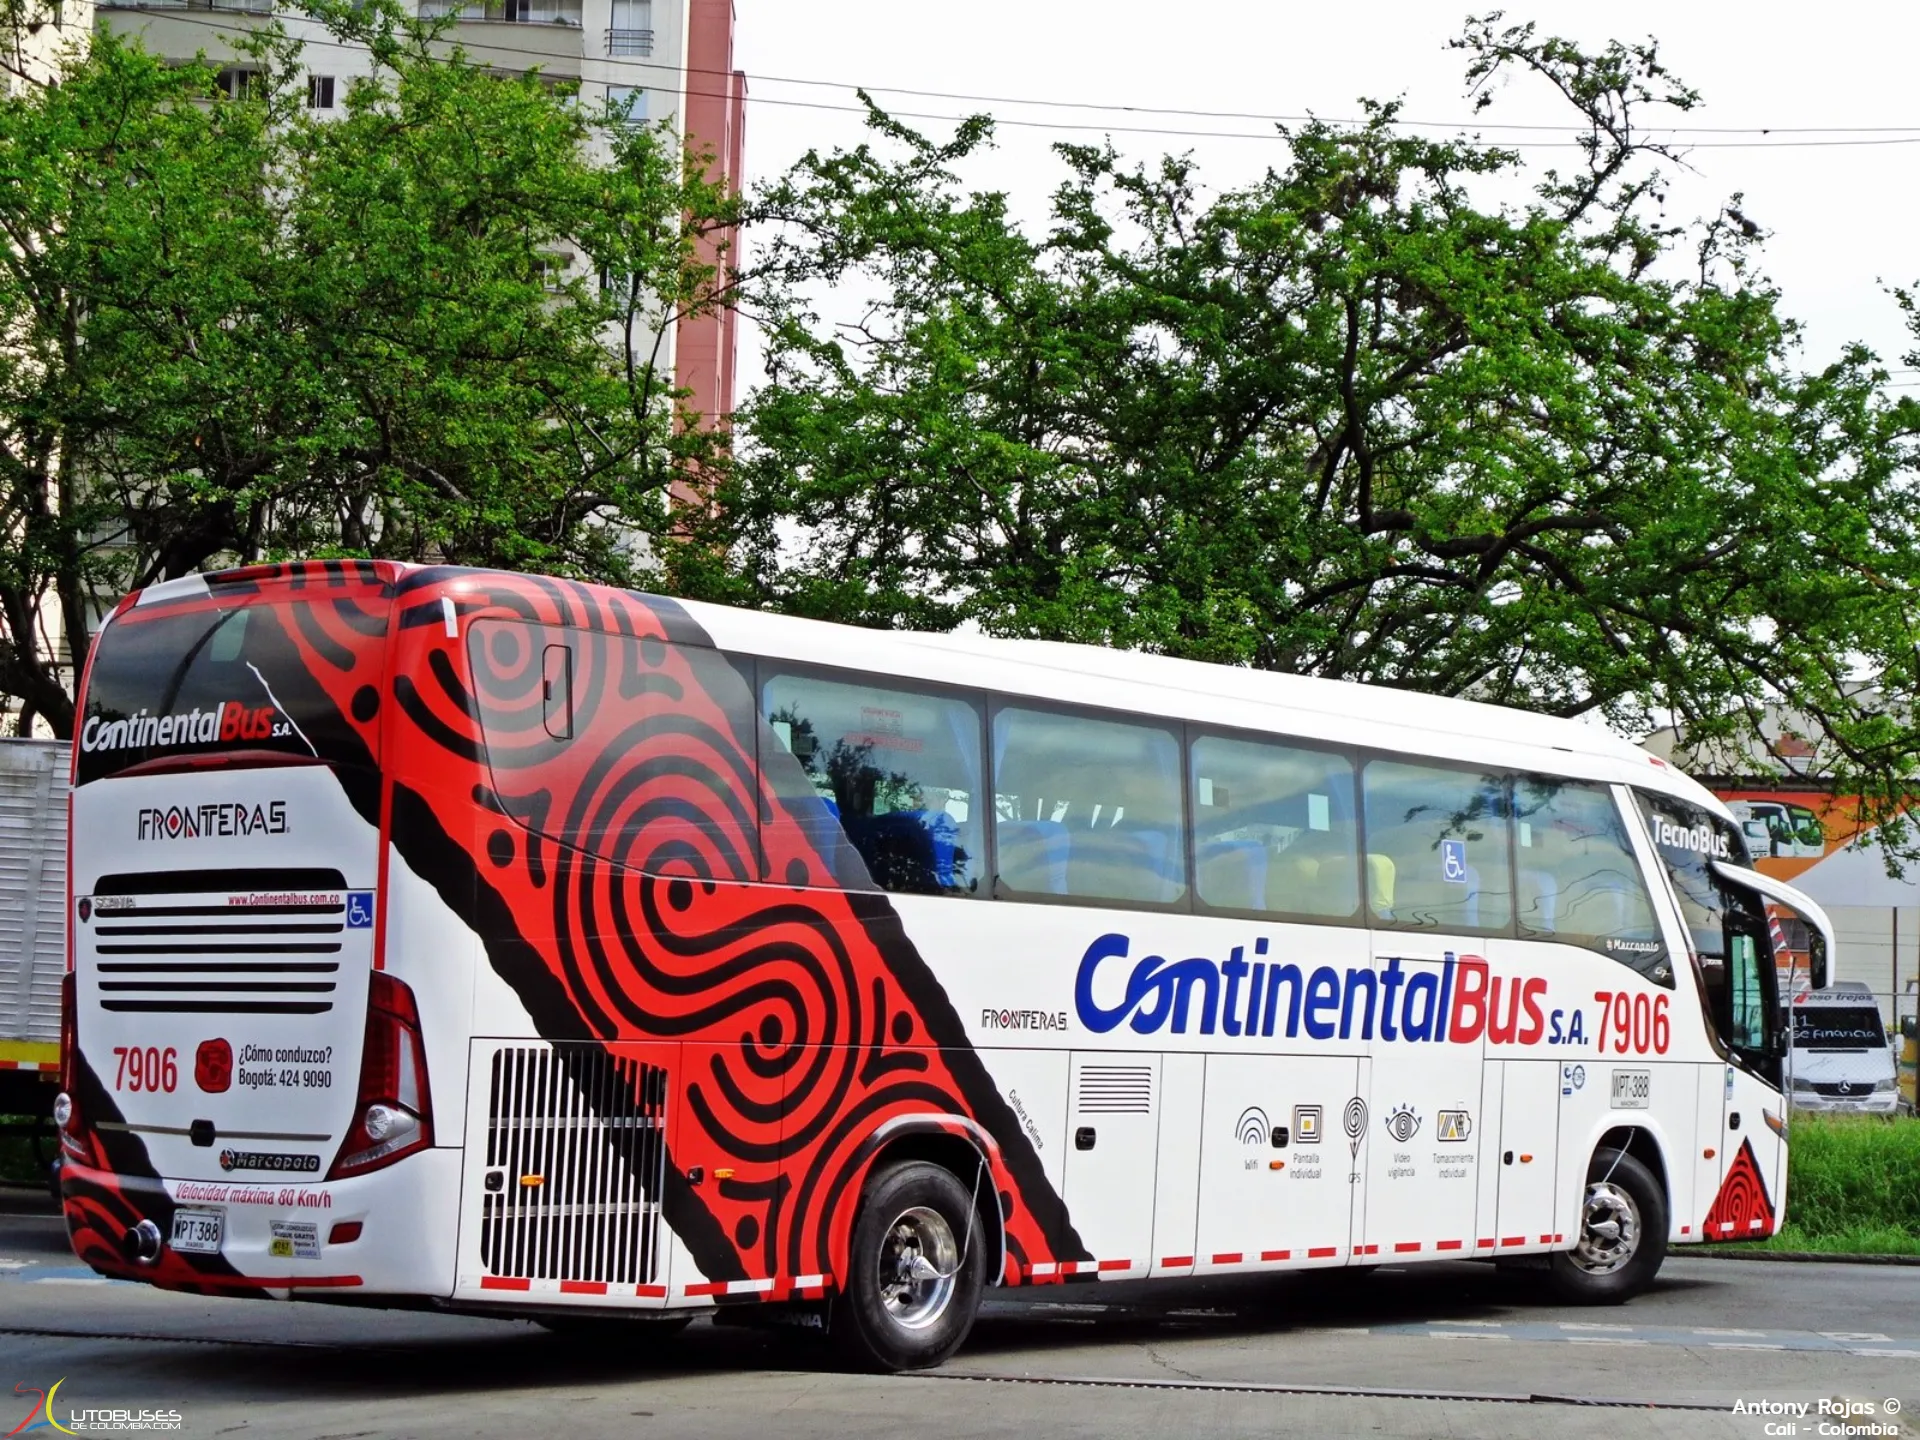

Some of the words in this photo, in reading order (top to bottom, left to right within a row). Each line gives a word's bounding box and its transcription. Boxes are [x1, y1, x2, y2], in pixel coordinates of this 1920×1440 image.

[81, 702, 274, 753] ContinentalBus
[138, 801, 287, 840] FRONTERAS
[1613, 940, 1660, 952] Marcopolo
[1074, 933, 1547, 1046] ContinentalBus
[1549, 1009, 1589, 1045] S.A.
[981, 1009, 1068, 1031] FRONTERAS
[1594, 991, 1670, 1055] 7906
[239, 1044, 273, 1065] ¿Cómo
[275, 1045, 332, 1063] conduzco?
[113, 1047, 178, 1092] 7906
[239, 1068, 277, 1090] Bogotá:
[279, 1069, 300, 1087] 424
[303, 1070, 331, 1088] 9090
[1612, 1075, 1649, 1098] WPT-388
[1009, 1089, 1027, 1121] Cultura
[1026, 1119, 1043, 1149] Calima
[236, 1153, 317, 1170] Marcopolo
[176, 1182, 228, 1202] Velocidad
[230, 1186, 274, 1205] máxima
[278, 1189, 294, 1206] 80
[298, 1189, 331, 1208] Km/h
